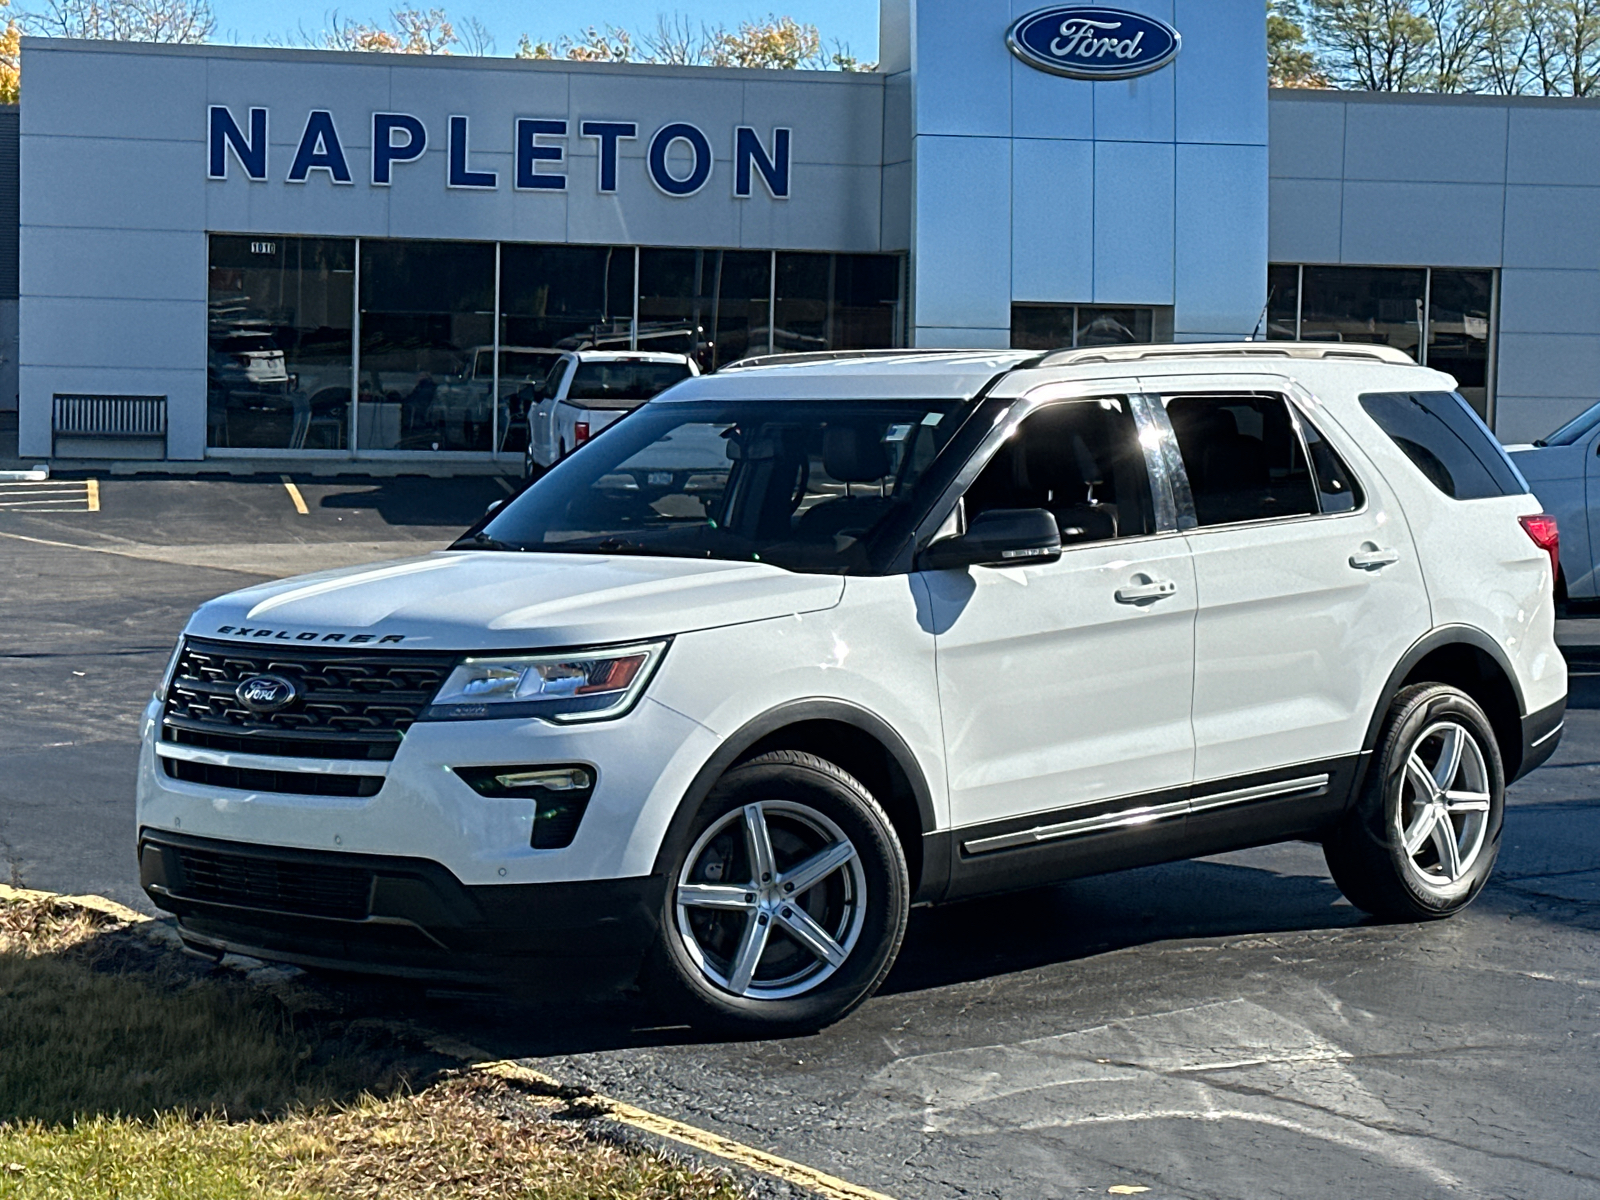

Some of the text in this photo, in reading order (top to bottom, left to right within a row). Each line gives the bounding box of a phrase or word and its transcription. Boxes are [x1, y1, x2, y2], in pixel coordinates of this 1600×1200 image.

[1050, 18, 1145, 59] Ford
[207, 105, 792, 198] NAPLETON
[217, 626, 406, 644] EXPLORER
[244, 680, 278, 701] Ford
